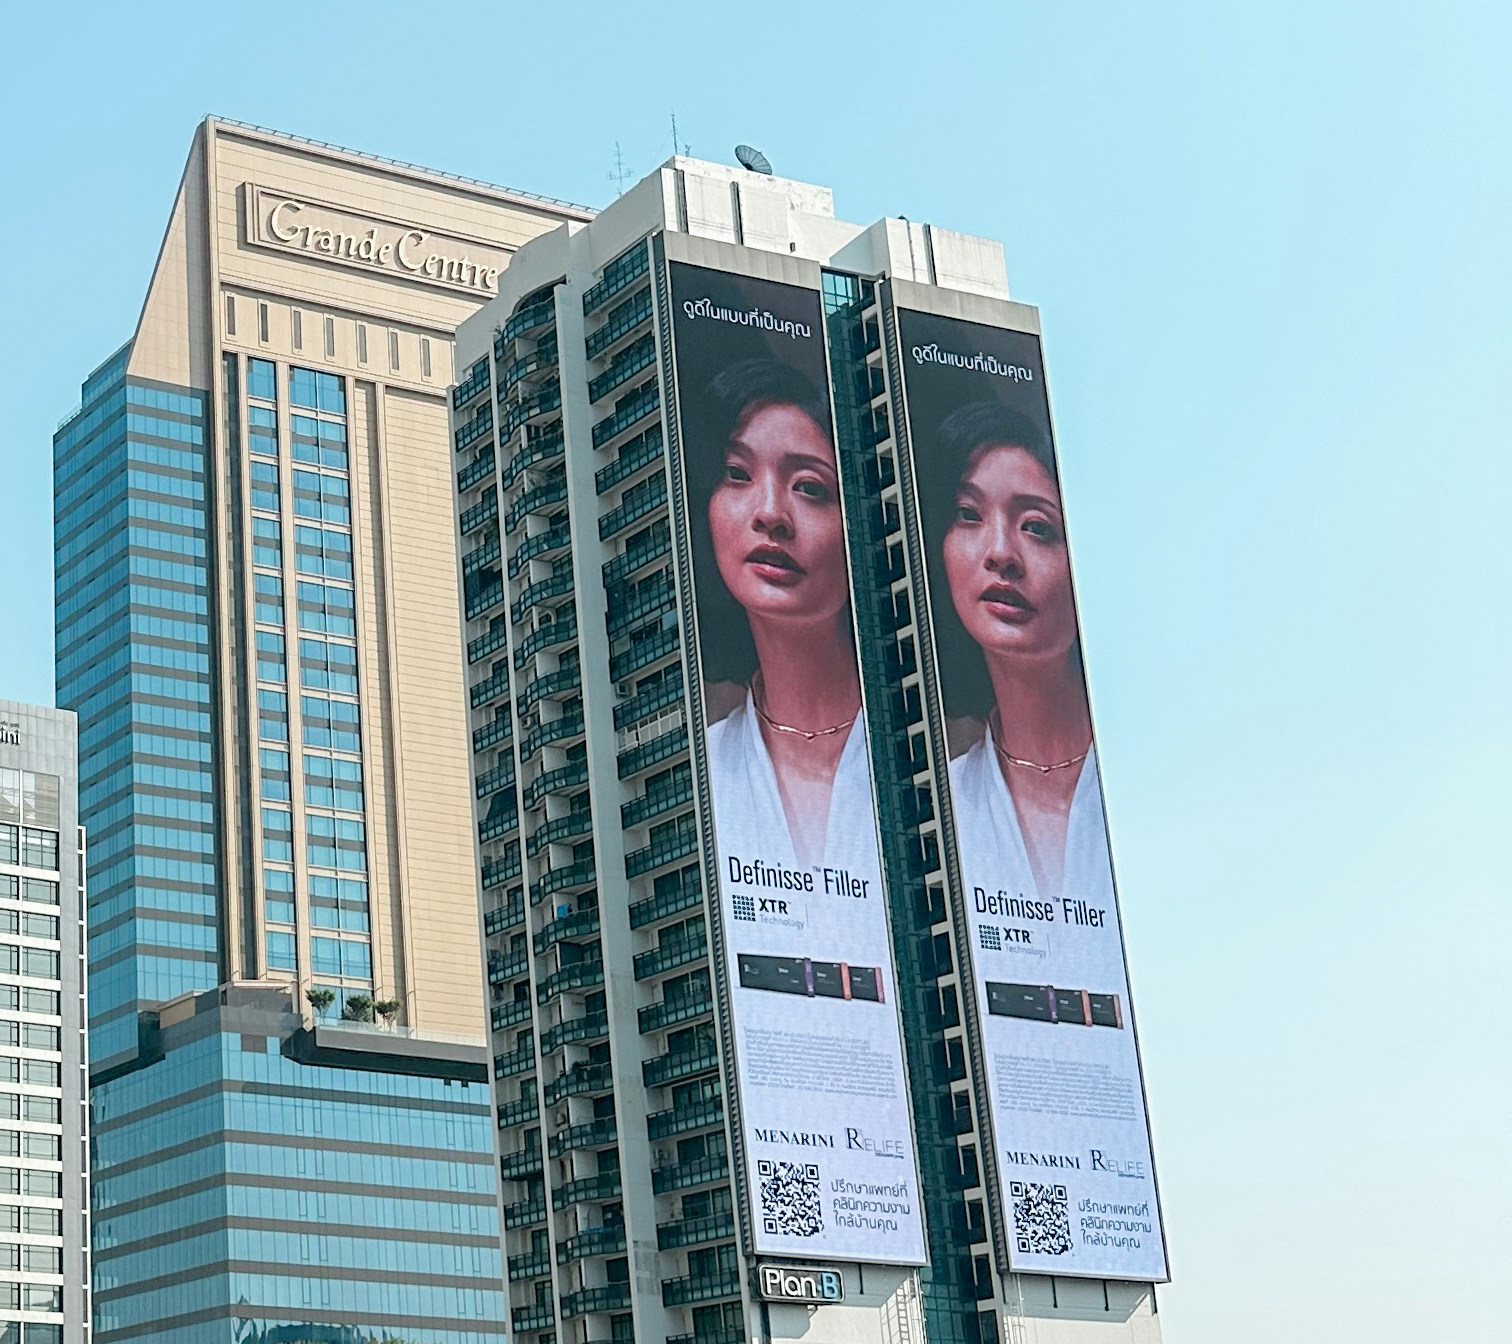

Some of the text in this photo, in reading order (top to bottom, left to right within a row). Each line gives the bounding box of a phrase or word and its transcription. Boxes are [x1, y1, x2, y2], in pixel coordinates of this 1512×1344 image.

[270, 200, 498, 289] Grande Centre
[683, 298, 811, 339] ดูดีในแบบที่เป็นคุณ
[912, 343, 1033, 383] ดูดีในแบบที่เป็นคุณ
[824, 868, 869, 898] Filler
[759, 914, 805, 930] Technology
[1063, 898, 1105, 927] Filler
[1005, 943, 1047, 958] Technology
[755, 1128, 904, 1154] MENARINI RELIFE
[1006, 1151, 1081, 1170] MENARINI
